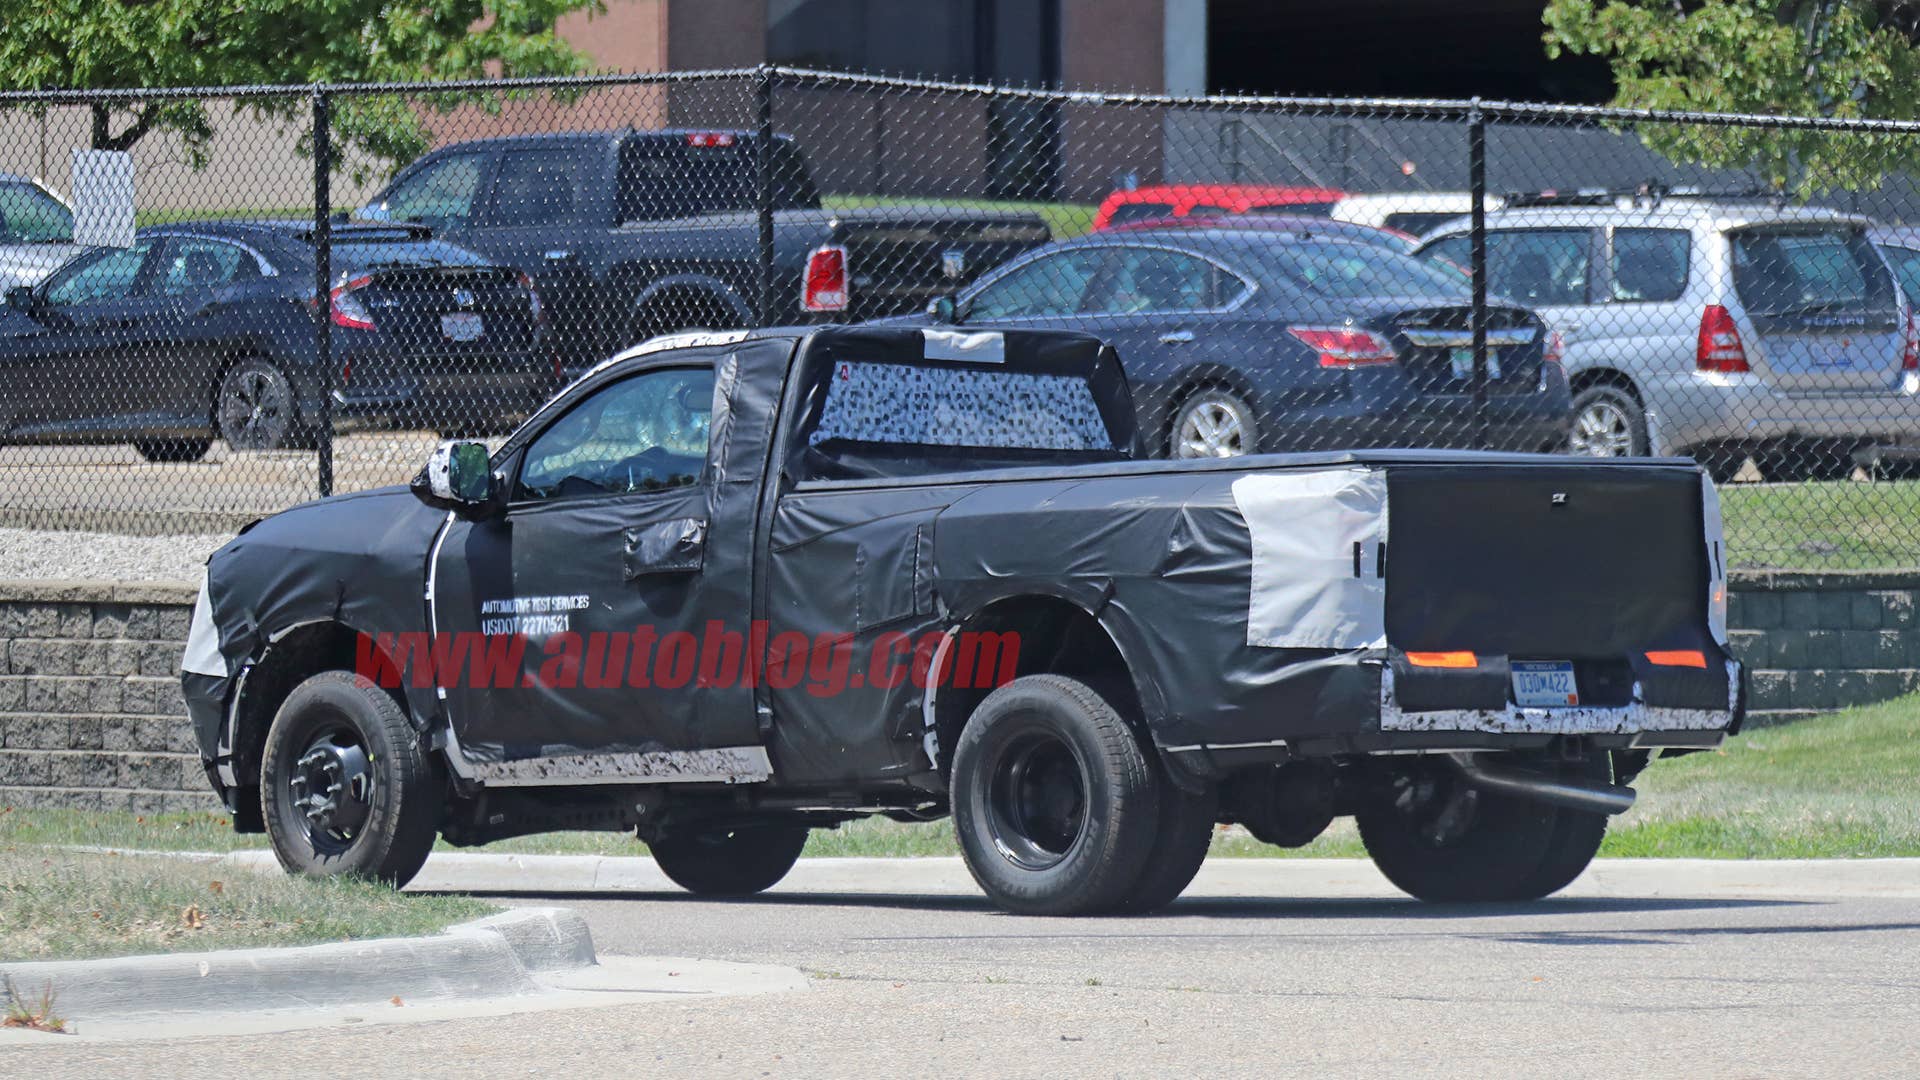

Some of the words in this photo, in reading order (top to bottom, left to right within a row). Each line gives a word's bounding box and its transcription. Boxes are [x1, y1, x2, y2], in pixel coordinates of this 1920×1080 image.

[481, 598, 531, 614] AUTOMOTIVE
[531, 596, 551, 613] TEST
[551, 594, 590, 611] SERVICES
[482, 616, 520, 636] USDOT
[521, 614, 570, 636] 2270521
